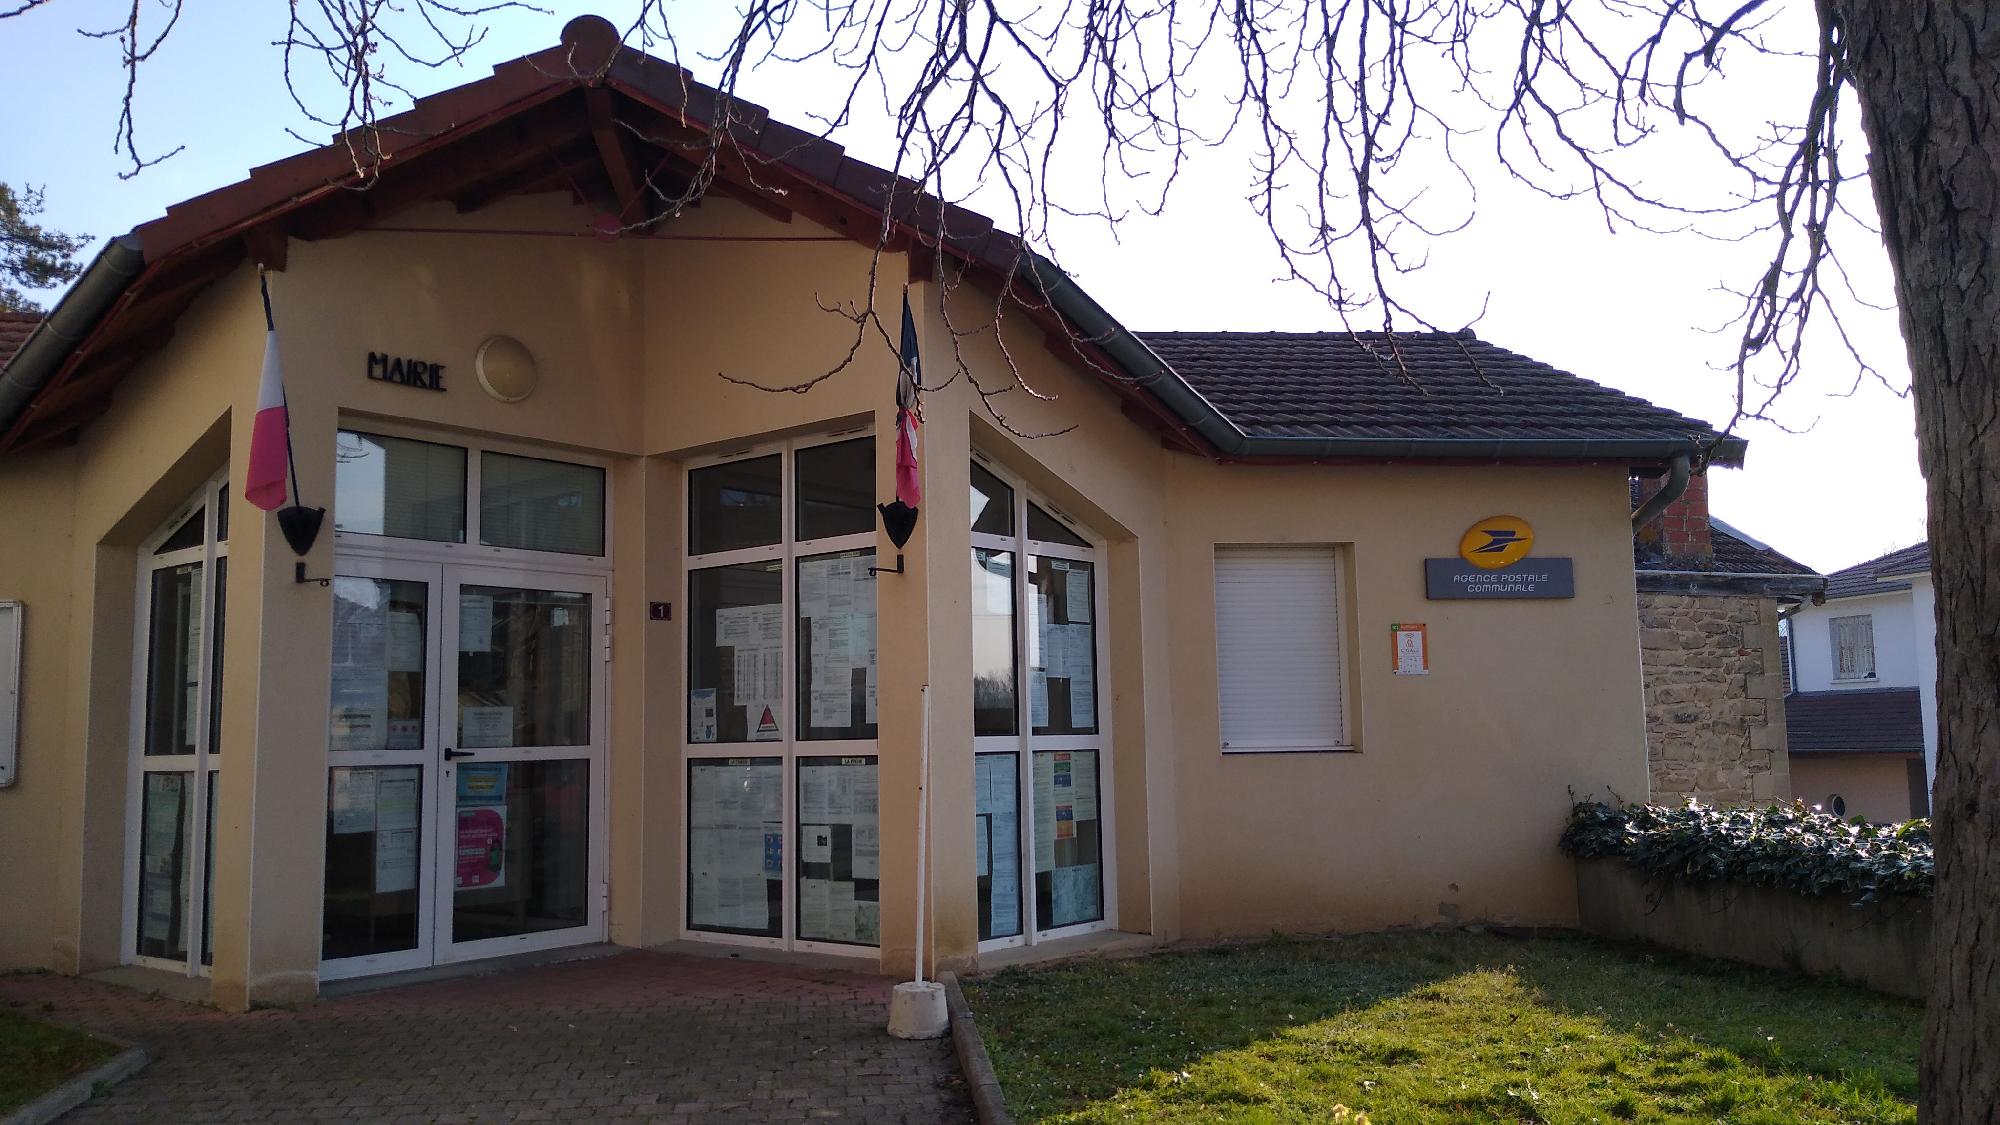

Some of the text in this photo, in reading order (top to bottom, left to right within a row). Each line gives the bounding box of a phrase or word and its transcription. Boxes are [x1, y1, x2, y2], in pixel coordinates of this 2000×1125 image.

[367, 351, 448, 392] MAIRIE
[1453, 574, 1549, 583] AGENCE POSTALE
[1467, 584, 1535, 593] COMMUNALE
[658, 605, 664, 617] 1
